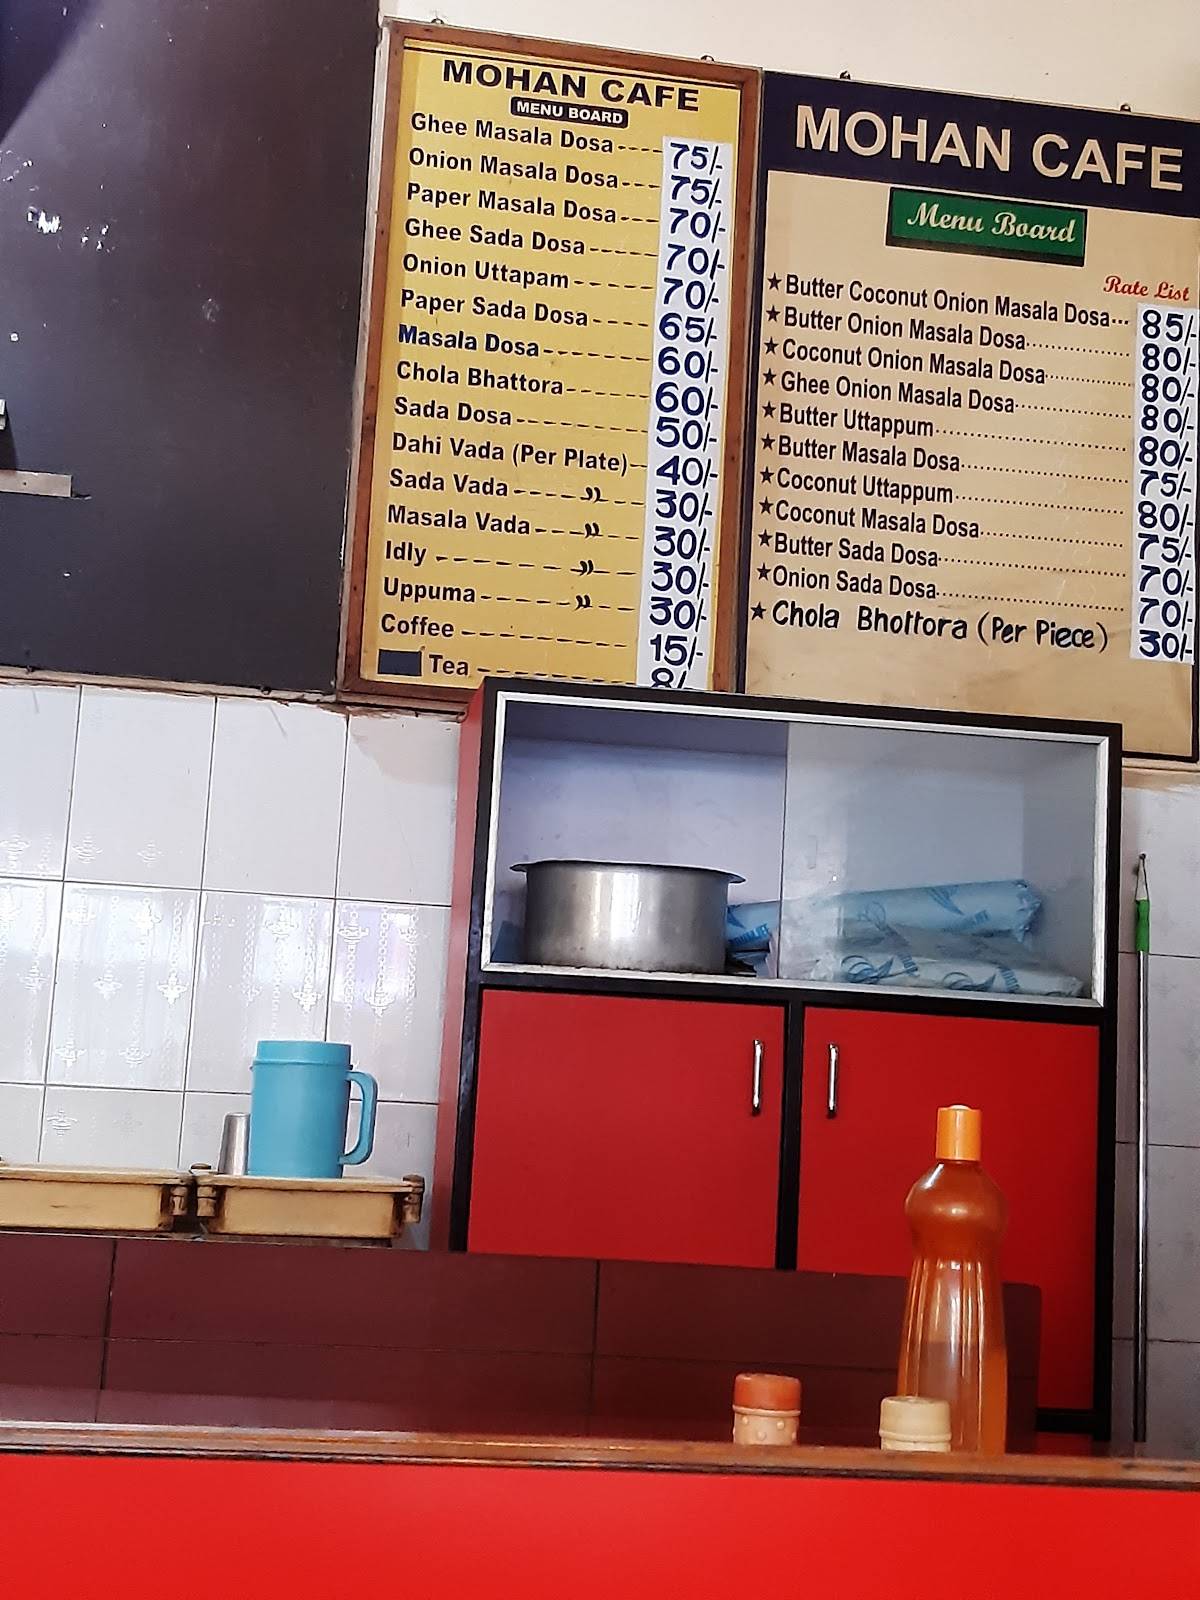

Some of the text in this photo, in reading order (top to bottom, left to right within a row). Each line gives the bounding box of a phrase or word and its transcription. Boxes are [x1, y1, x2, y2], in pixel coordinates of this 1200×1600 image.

[443, 60, 700, 112] MOHAN CAFE
[517, 101, 623, 124] MENU BOARD
[411, 112, 723, 173] Ghee Masala Dosa 75/-
[796, 105, 1183, 191] MOHAN CAFE
[409, 148, 722, 209] Onion Masala Dosa 75/-
[407, 183, 726, 243] Paper Masala Dosa 70/-
[907, 202, 1076, 244] Menu Board
[404, 218, 725, 278] Ghee Sada Dosa 70/-
[403, 253, 720, 312] Onion Uttapam 70/-
[786, 274, 1197, 346] Butter Coconut Onion Masala Dosa 85/-
[1103, 275, 1191, 301] Rate List
[401, 289, 718, 347] Paper Sada Dosa 65/-
[784, 306, 1196, 375] Butter Onion Masala Dosa 80/-
[398, 324, 719, 382] Masala Dosa 60/-
[782, 339, 1194, 406] Coconut Onion Masala Dosa 80/-
[397, 361, 719, 421] Chola Bhattora 60/-
[781, 370, 1194, 439] Ghee Onion Masala Dosa 80/-
[394, 397, 718, 452] Sada Dosa 50/-
[780, 403, 1192, 470] Butter Uttappum 80/-
[392, 432, 719, 488] Dahi Vada (Per Plate) 40/-
[778, 435, 1192, 500] Butter Masala Dosa 75/-
[390, 468, 713, 526] Sada Vada 30/-
[777, 468, 1193, 537] Coconut Uttappum 80/-
[387, 504, 711, 562] Masala Vada 30/-
[776, 500, 1192, 566] Coconut Masala Dosa 75/-
[385, 541, 710, 599] Idly 30/-
[774, 532, 1193, 597] Butter Sada Dosa 70/-
[383, 577, 707, 632] Uppuma 30/-
[773, 565, 1193, 631] Onion Sada Dosa 70/-
[381, 614, 704, 669] Coffee 15/-
[772, 600, 840, 629] Chola
[977, 612, 1027, 645] (Per
[1036, 619, 1109, 653] Piece)
[1139, 630, 1192, 661] 30/-
[429, 654, 693, 689] Tea 8/
